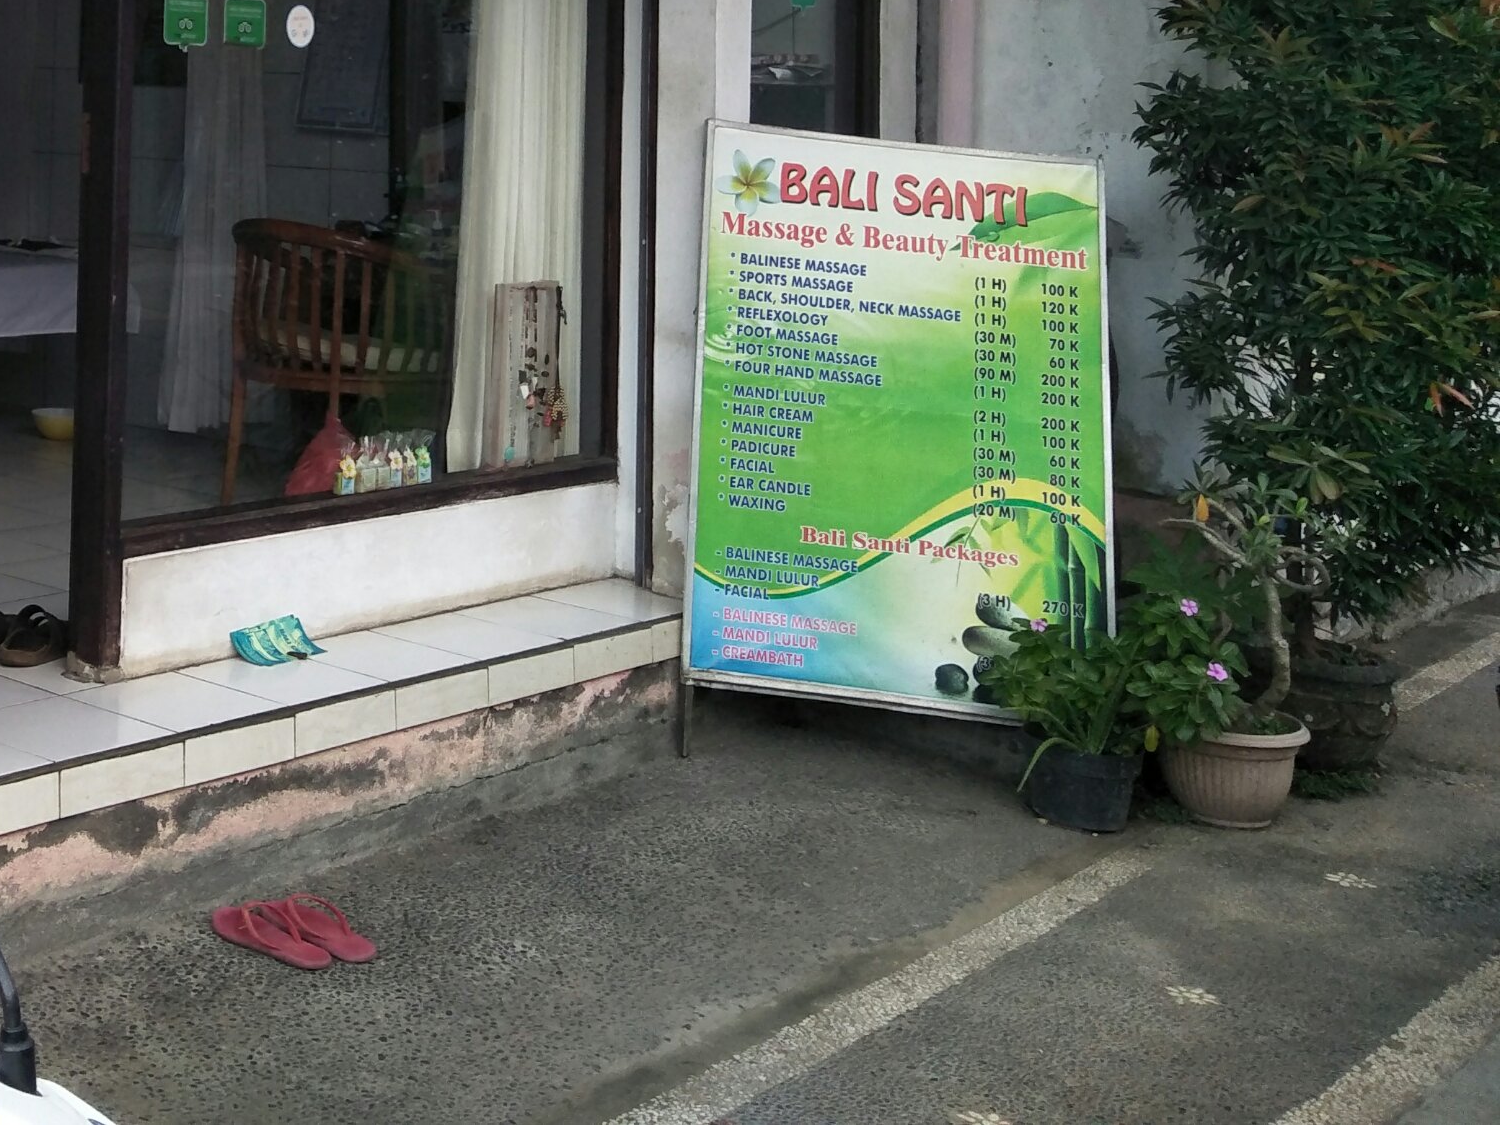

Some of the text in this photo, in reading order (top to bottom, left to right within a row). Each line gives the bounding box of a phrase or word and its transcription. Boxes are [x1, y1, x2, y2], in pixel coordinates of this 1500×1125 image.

[779, 162, 1029, 227] BALI SANTI
[721, 211, 1088, 270] Massage & Beauty Treatment
[740, 252, 867, 277] BALINESE MASSAGE
[739, 270, 854, 294] SPORTS MASSAGE
[737, 306, 829, 327] REFLEXOLOGY
[738, 289, 962, 323] BACK, SHOULDER, NECK MASSAGE
[736, 324, 839, 346] FOOT MASSAGE
[735, 342, 878, 368] HOT STONE MASSAGE
[734, 361, 883, 387] FOUR HAND MASSAGE
[733, 384, 826, 407] MANDI LULUR
[732, 402, 814, 423] HAIR CREAM
[731, 421, 803, 441] MANICURE
[730, 439, 796, 459] PADICURE
[729, 458, 775, 475] FACIAL
[729, 476, 811, 497] EAR CANDLE
[728, 494, 786, 513] WAXING
[800, 525, 1020, 569] Bali Santi Packages
[725, 546, 859, 574] BALINESE MASSAGE
[724, 565, 820, 588] MANDI LULUR
[723, 584, 770, 601] FACIAL
[723, 607, 857, 636] BALINESE MASSAGE
[722, 626, 818, 650] MANDI LULUR
[722, 645, 804, 667] CREAMBATH
